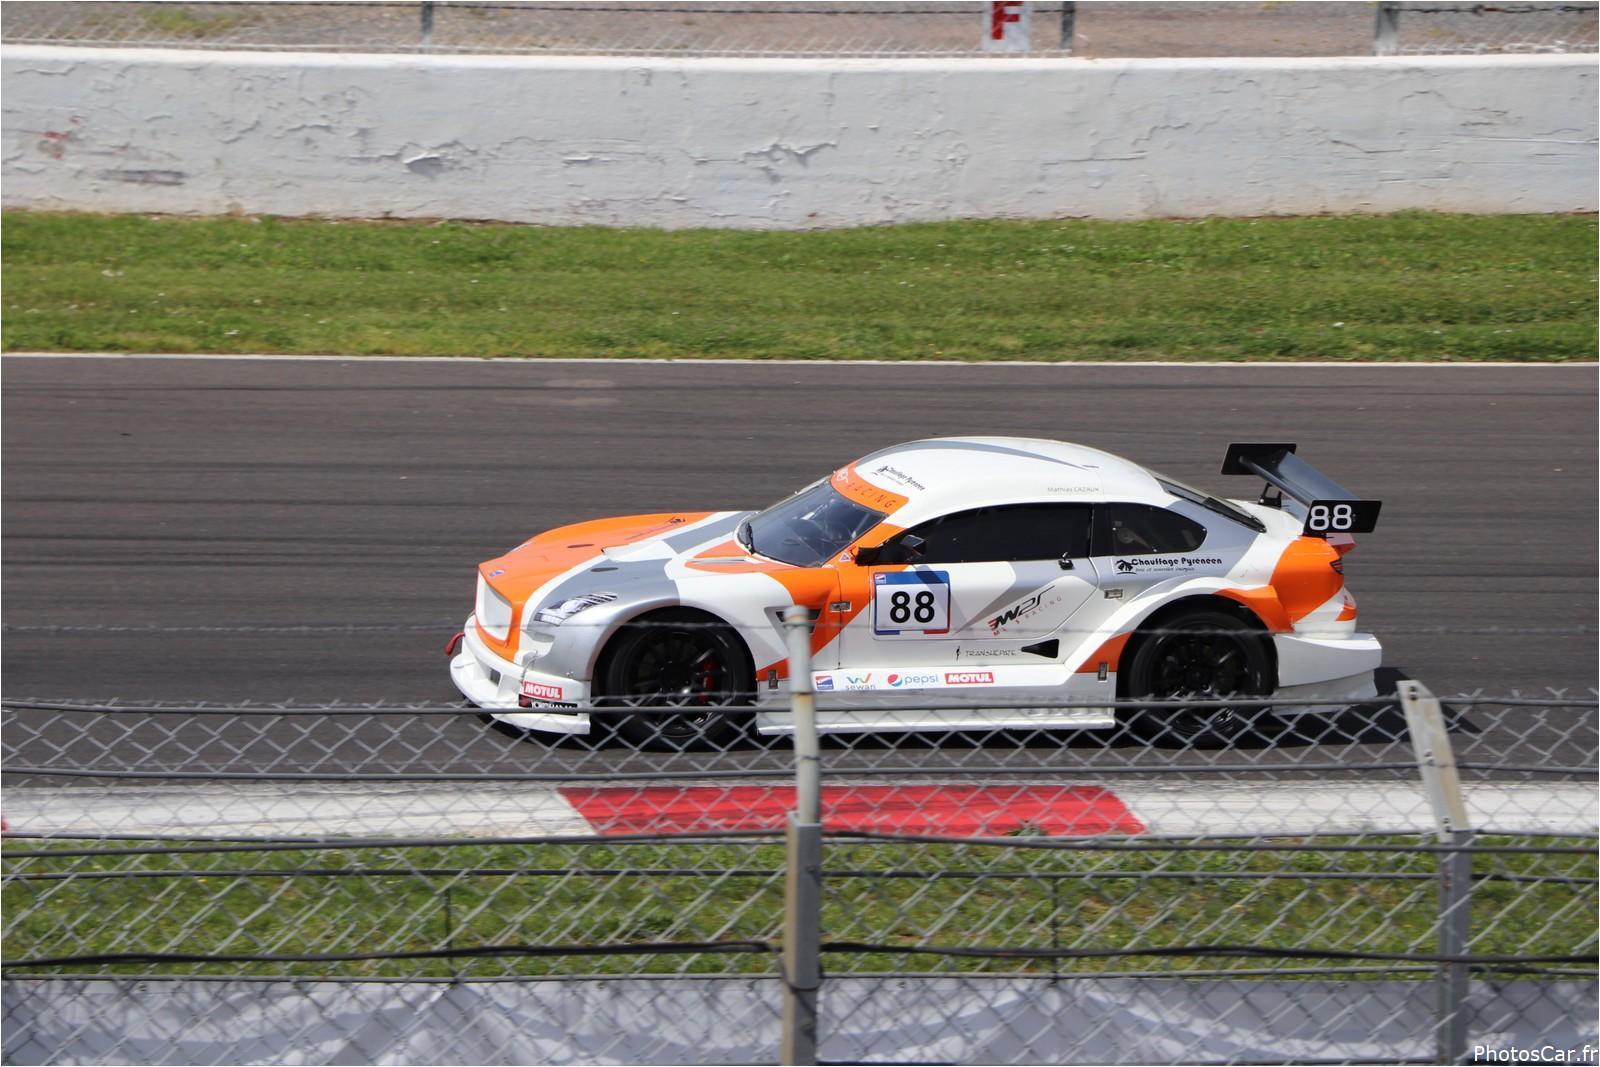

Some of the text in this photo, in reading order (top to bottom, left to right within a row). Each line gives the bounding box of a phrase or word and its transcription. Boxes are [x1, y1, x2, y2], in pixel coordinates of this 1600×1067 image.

[992, 1, 1025, 40] F
[1309, 504, 1352, 531] 88
[1131, 557, 1179, 567] Chauffage
[890, 591, 935, 624] 88
[904, 674, 939, 686] pepsi
[947, 673, 993, 684] MOTUL
[525, 683, 561, 699] MOTUL
